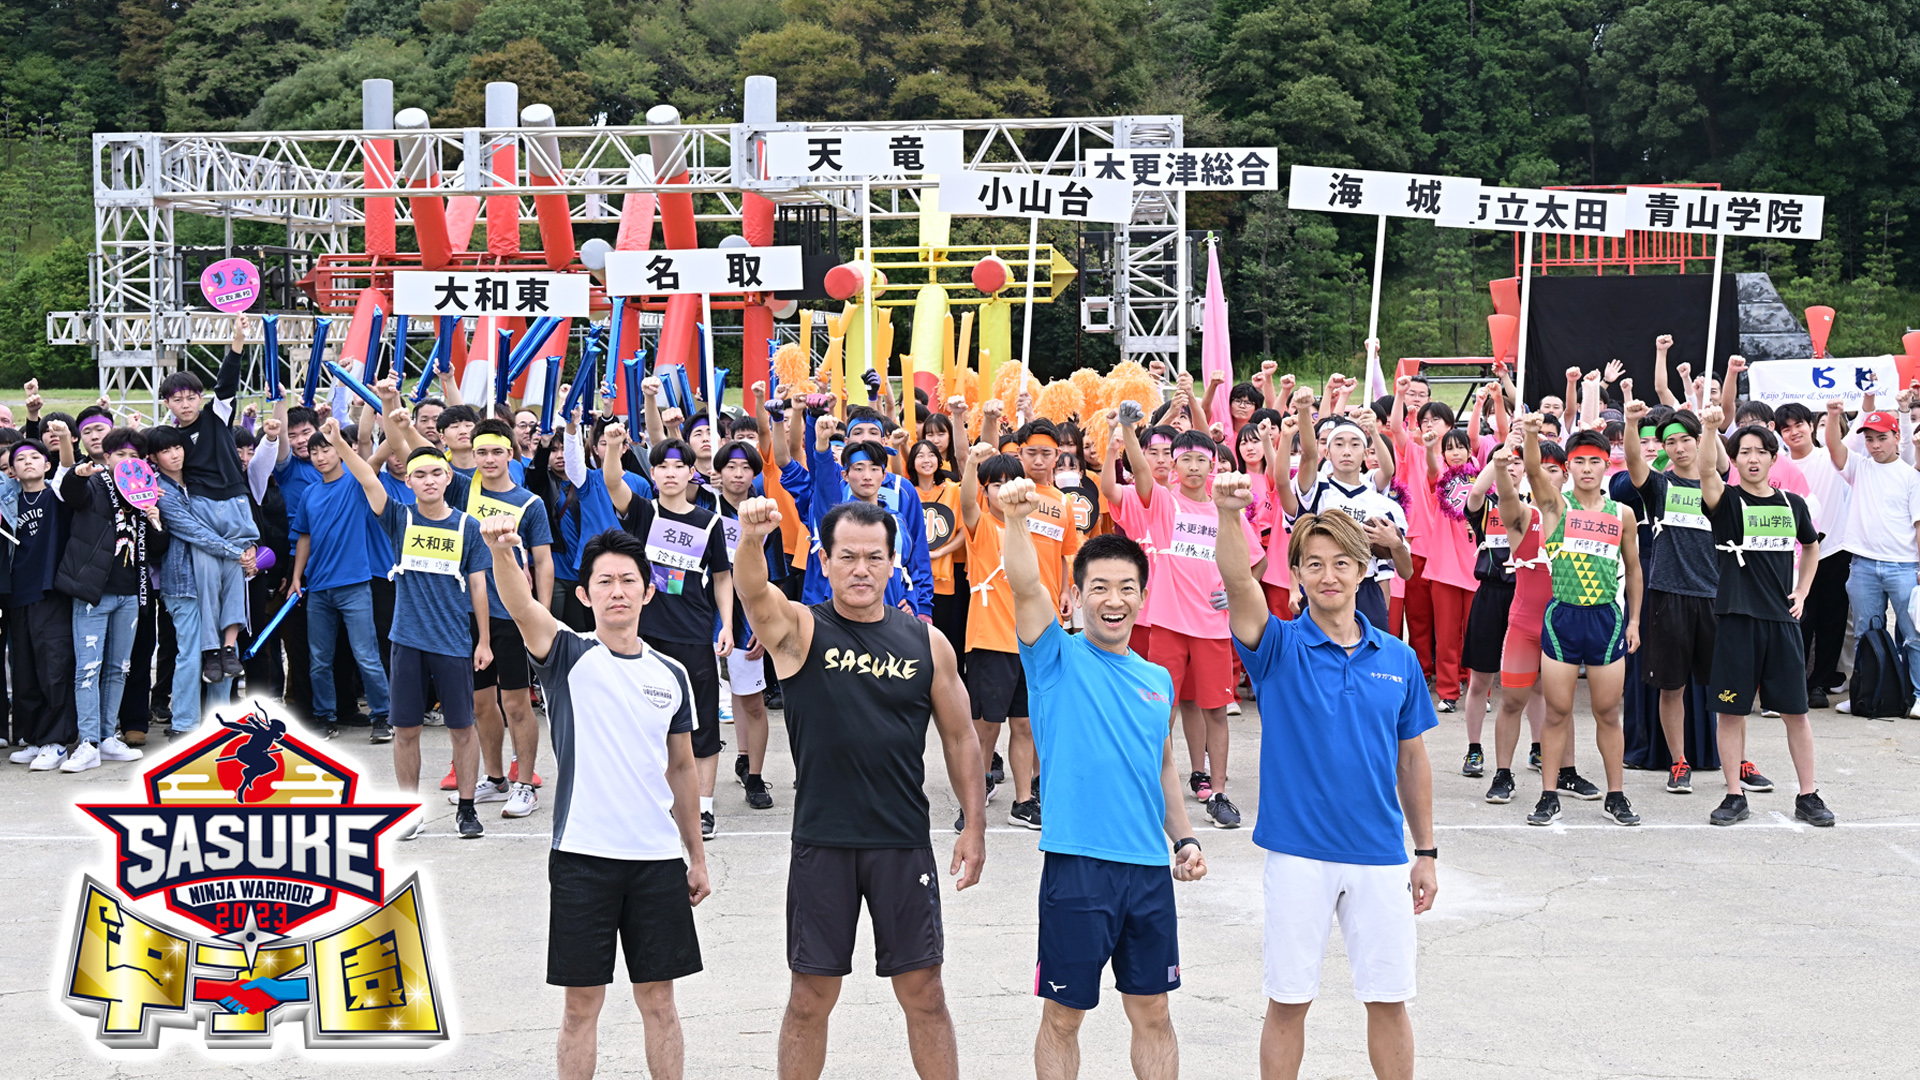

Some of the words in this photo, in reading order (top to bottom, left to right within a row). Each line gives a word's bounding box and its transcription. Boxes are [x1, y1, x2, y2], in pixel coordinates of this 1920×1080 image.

[1093, 152, 1270, 187] 木更津総合
[978, 176, 1094, 217] 小山台
[1645, 193, 1802, 233] 青山学院
[211, 268, 248, 288] りお
[216, 289, 251, 303] 名取高校
[434, 276, 550, 312] 大和東
[1759, 391, 1779, 401] Kaijo
[1780, 391, 1805, 400] Junior
[1817, 391, 1841, 400] Senior
[1841, 391, 1861, 401] High
[1038, 502, 1061, 519] 山台
[1671, 493, 1703, 508] 青山学
[1175, 521, 1218, 538] 木更津総
[1570, 518, 1619, 537] 市立太田
[1747, 515, 1792, 528] 青山学院
[137, 520, 147, 562] MONCLER
[411, 533, 456, 553] 大和東
[663, 527, 694, 548] 名取
[138, 566, 147, 607] MONCLER
[824, 647, 920, 680] SASUKE
